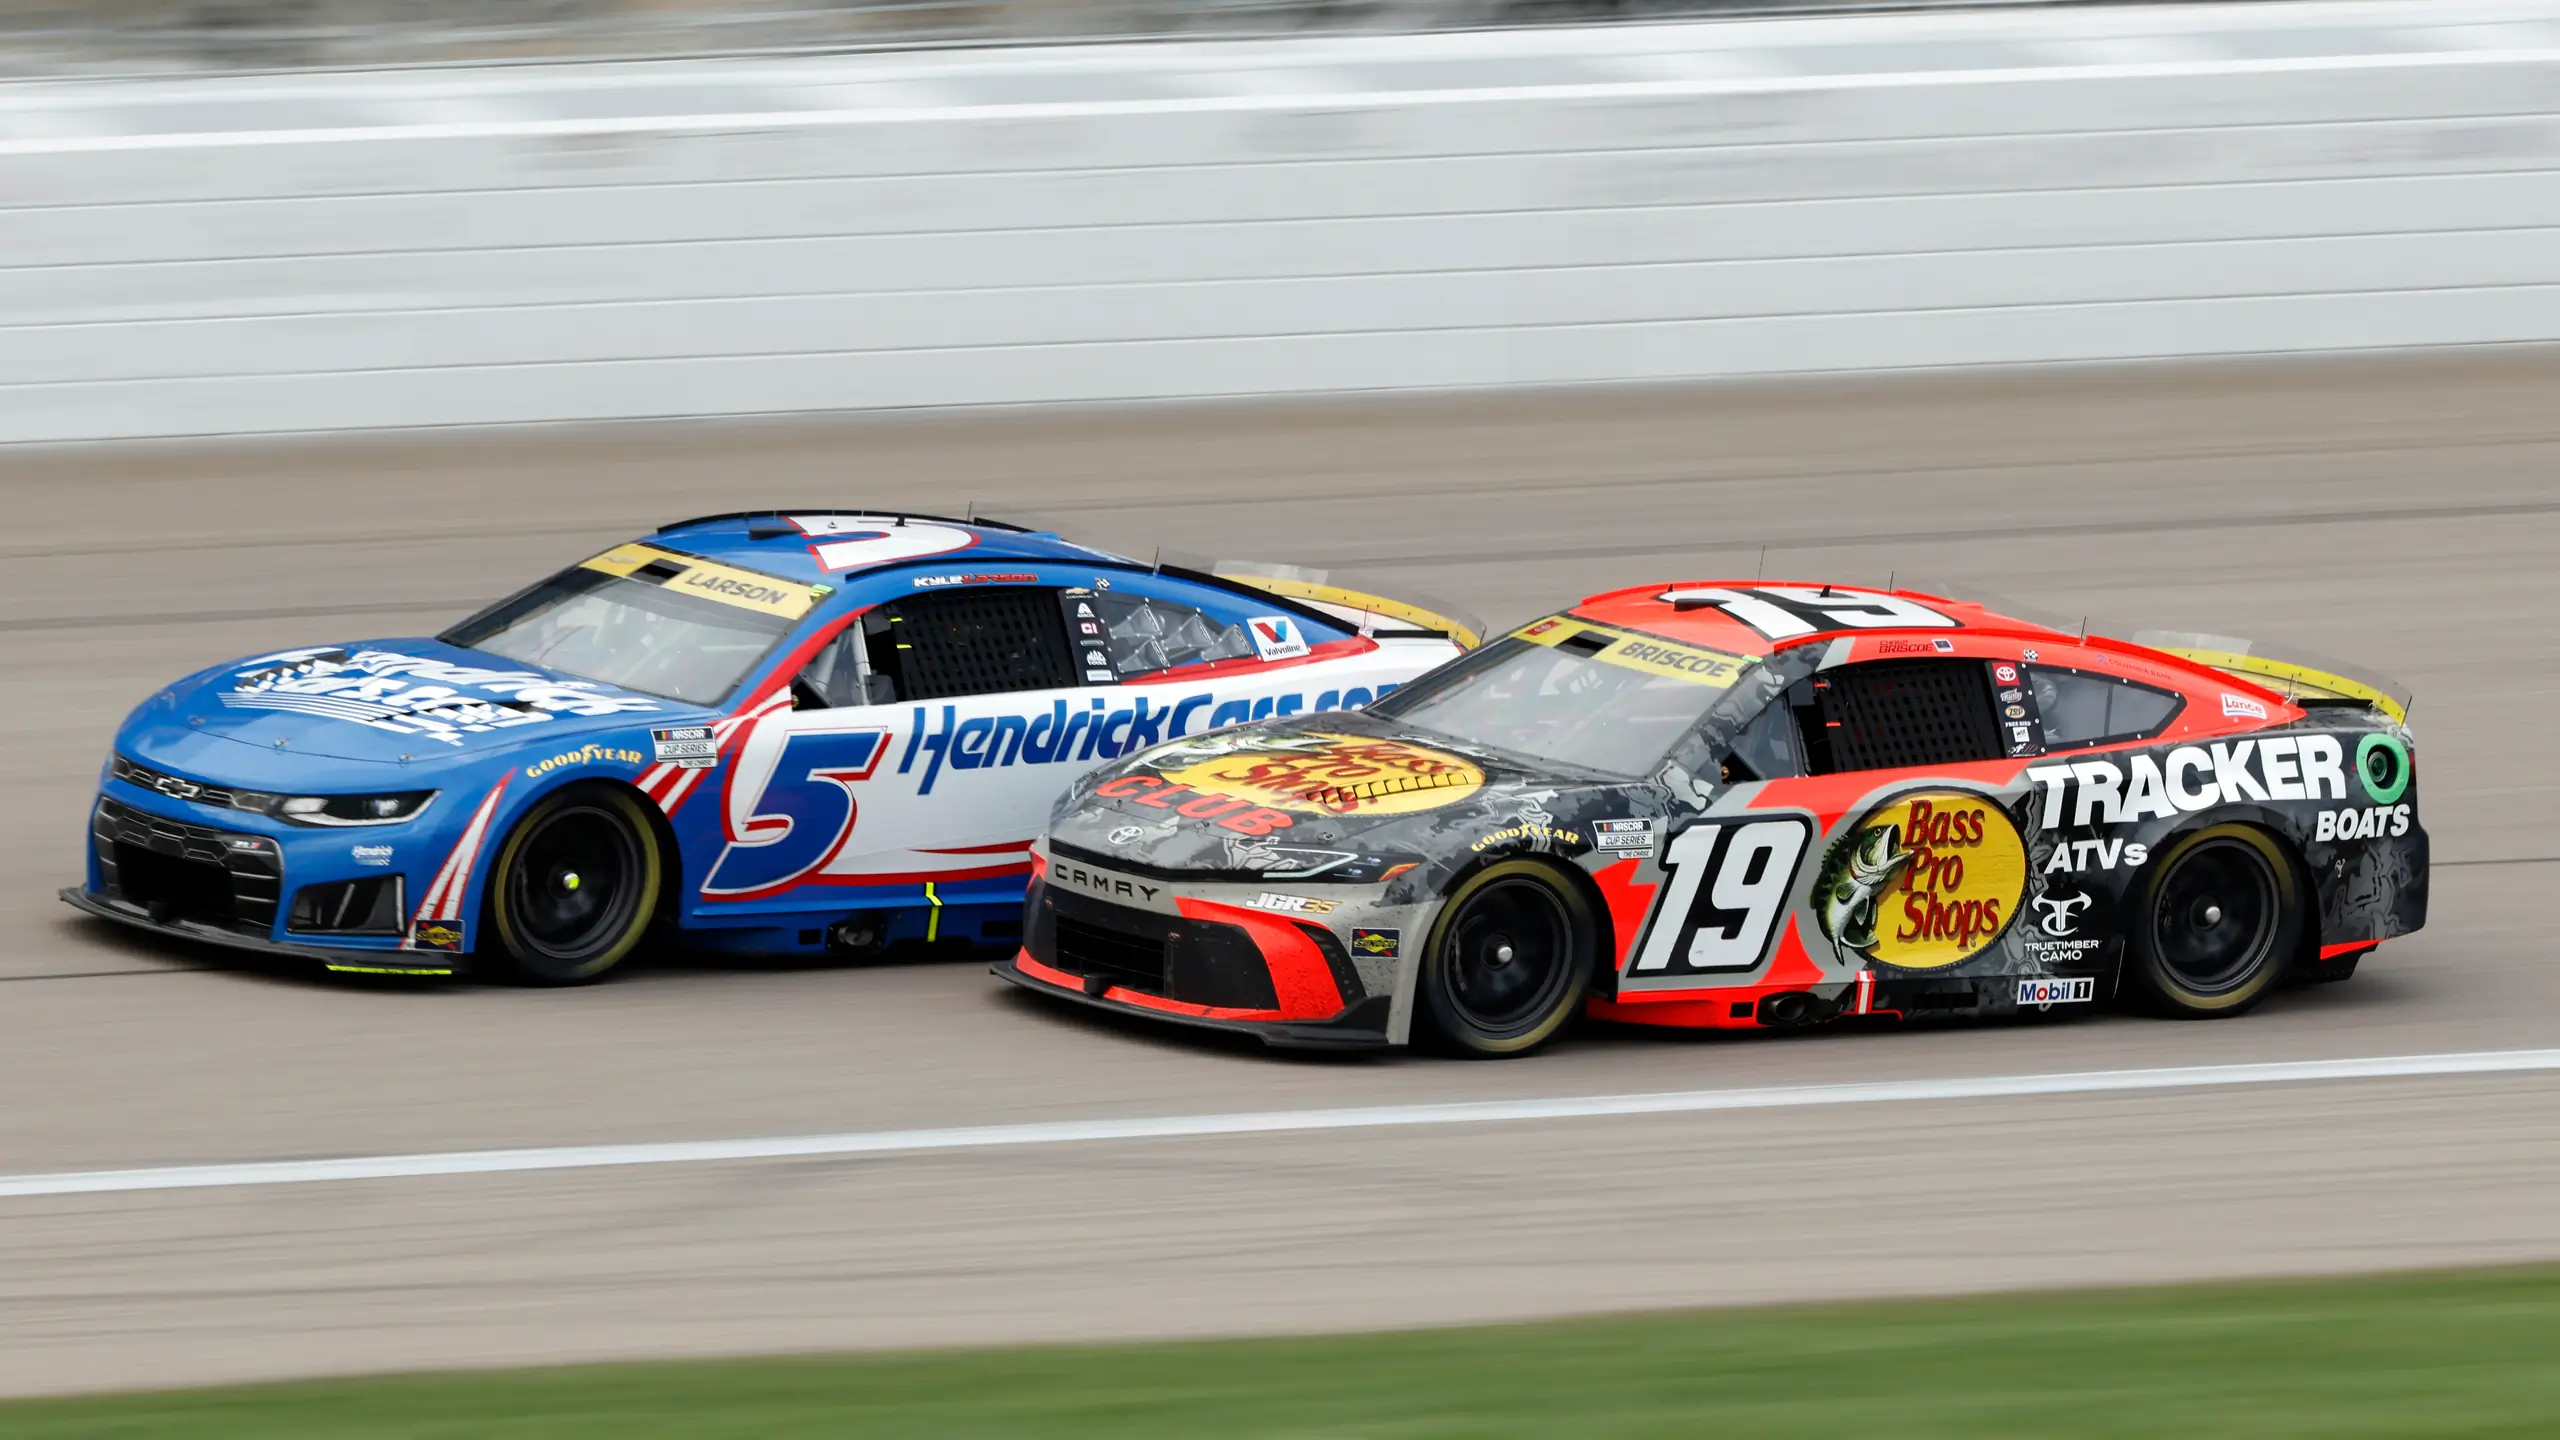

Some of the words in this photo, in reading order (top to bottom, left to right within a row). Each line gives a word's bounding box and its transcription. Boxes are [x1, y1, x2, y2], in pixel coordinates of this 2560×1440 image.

[685, 572, 788, 605] LARSON
[913, 574, 963, 588] KYLE
[1652, 586, 1960, 641] 19
[1265, 644, 1301, 656] Valvoline
[1616, 641, 1735, 679] BRISCOE
[1878, 642, 1934, 654] BRISCOE
[2225, 696, 2263, 714] Lance
[663, 743, 680, 754] CUP
[680, 743, 708, 754] SERIES
[671, 728, 706, 740] NASCAR
[526, 743, 644, 779] GOODYEAR
[2026, 733, 2348, 830] TRACKER
[702, 727, 888, 897] 5
[1095, 774, 1294, 836] CLUB
[1470, 822, 1580, 852] GOODYEAR
[1612, 821, 1644, 832] NASCAR
[1901, 799, 1985, 848] Bass
[2315, 804, 2412, 843] BOATS
[1605, 835, 1621, 846] CUP
[1620, 834, 1647, 845] SERIES
[1623, 850, 1634, 858] THE
[1901, 846, 1964, 894] Pro
[2044, 838, 2149, 875] ATVs
[1055, 862, 1161, 903] CAMRY
[1634, 819, 1808, 972] 19
[1897, 889, 2001, 950] Shops
[1353, 937, 1398, 950] SUNOCO
[2024, 939, 2100, 952] TRUETIMBER
[2039, 949, 2083, 963] CAMO
[2020, 981, 2071, 1002] Mobil
